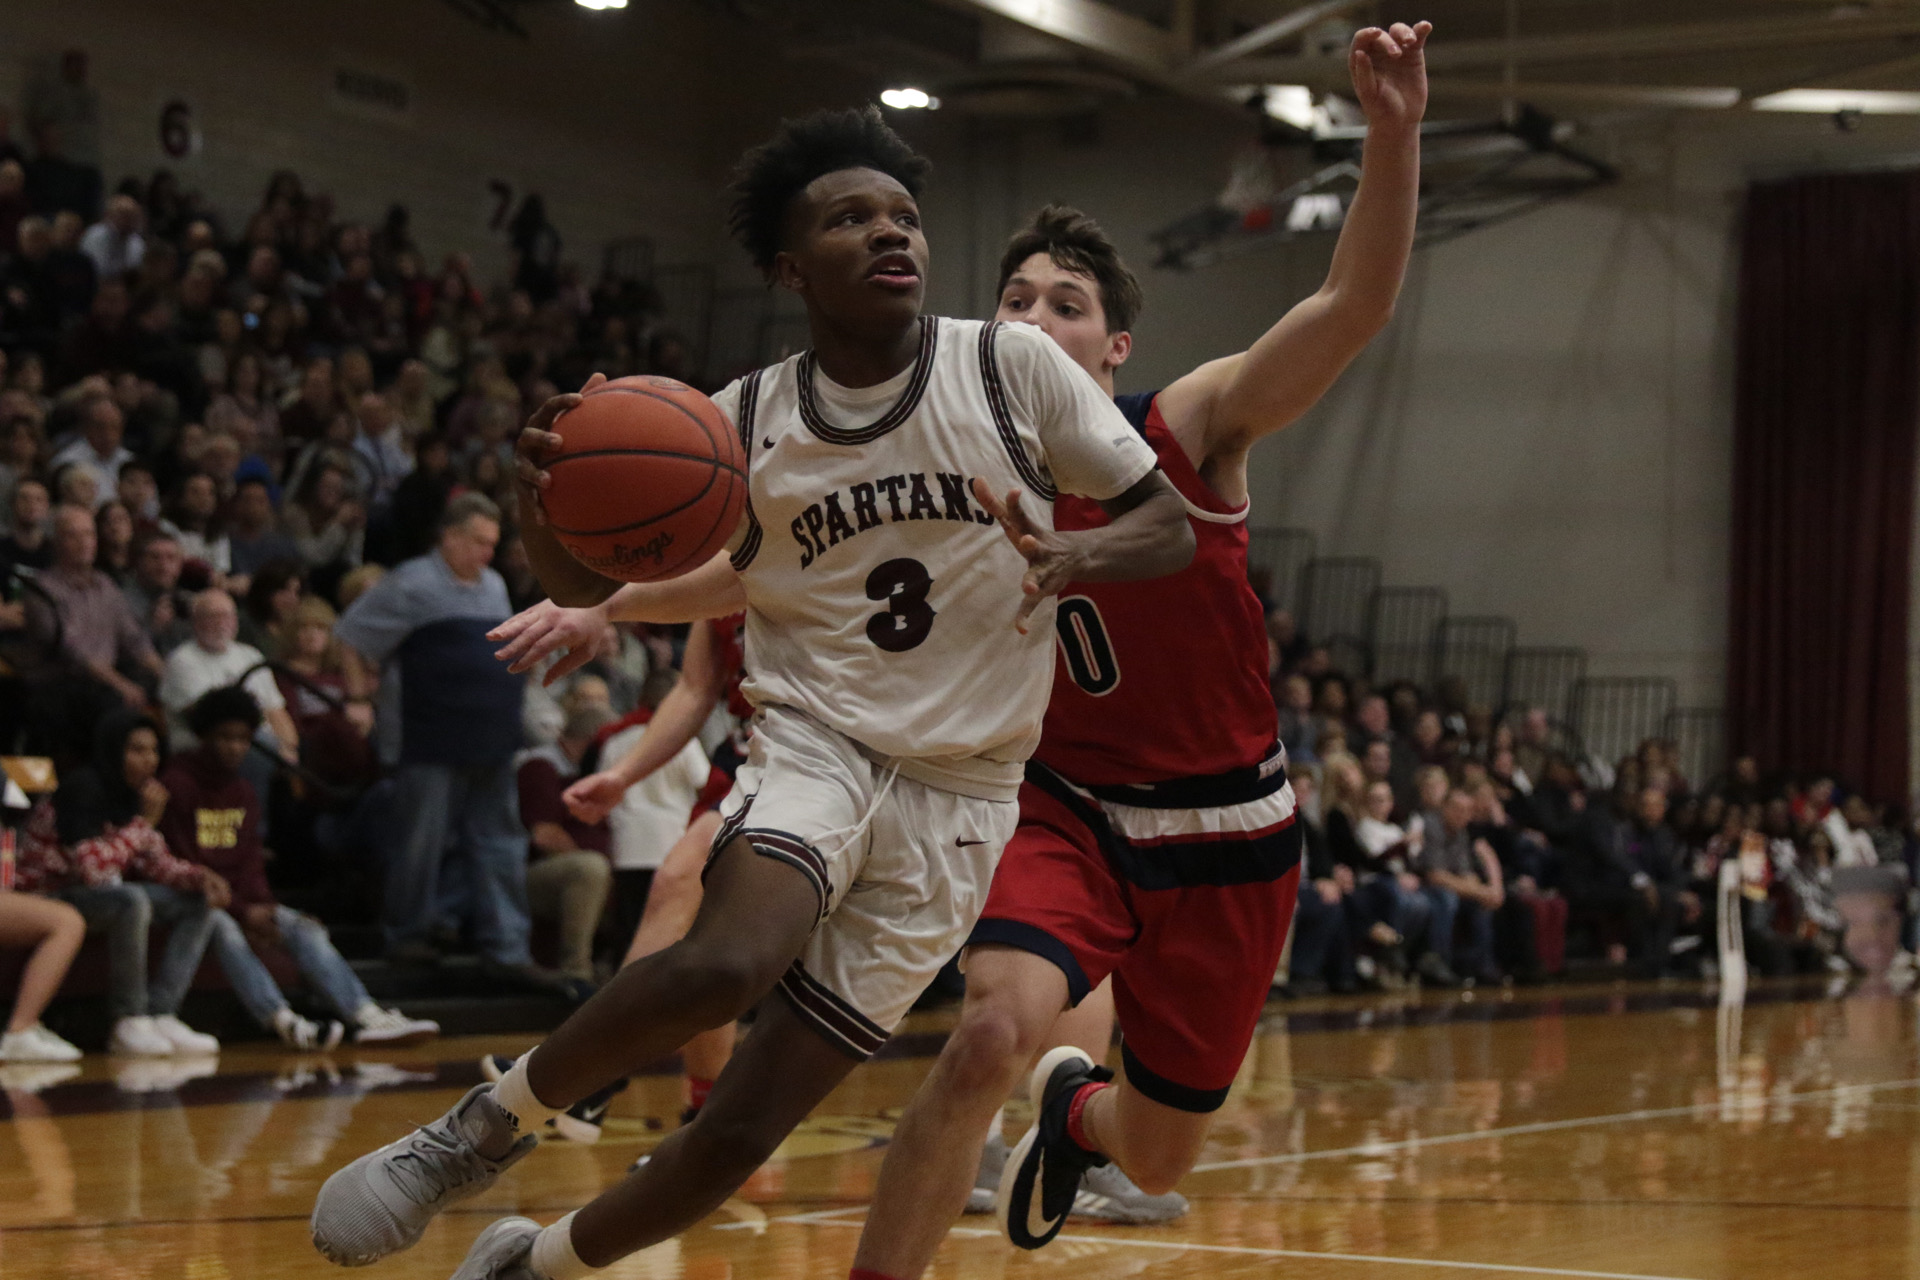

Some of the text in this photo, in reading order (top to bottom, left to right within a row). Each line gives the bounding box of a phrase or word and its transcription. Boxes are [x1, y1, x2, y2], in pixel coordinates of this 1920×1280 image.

[161, 102, 190, 158] 6
[488, 181, 512, 231] 7
[865, 557, 937, 652] 3
[1056, 594, 1121, 697] 0
